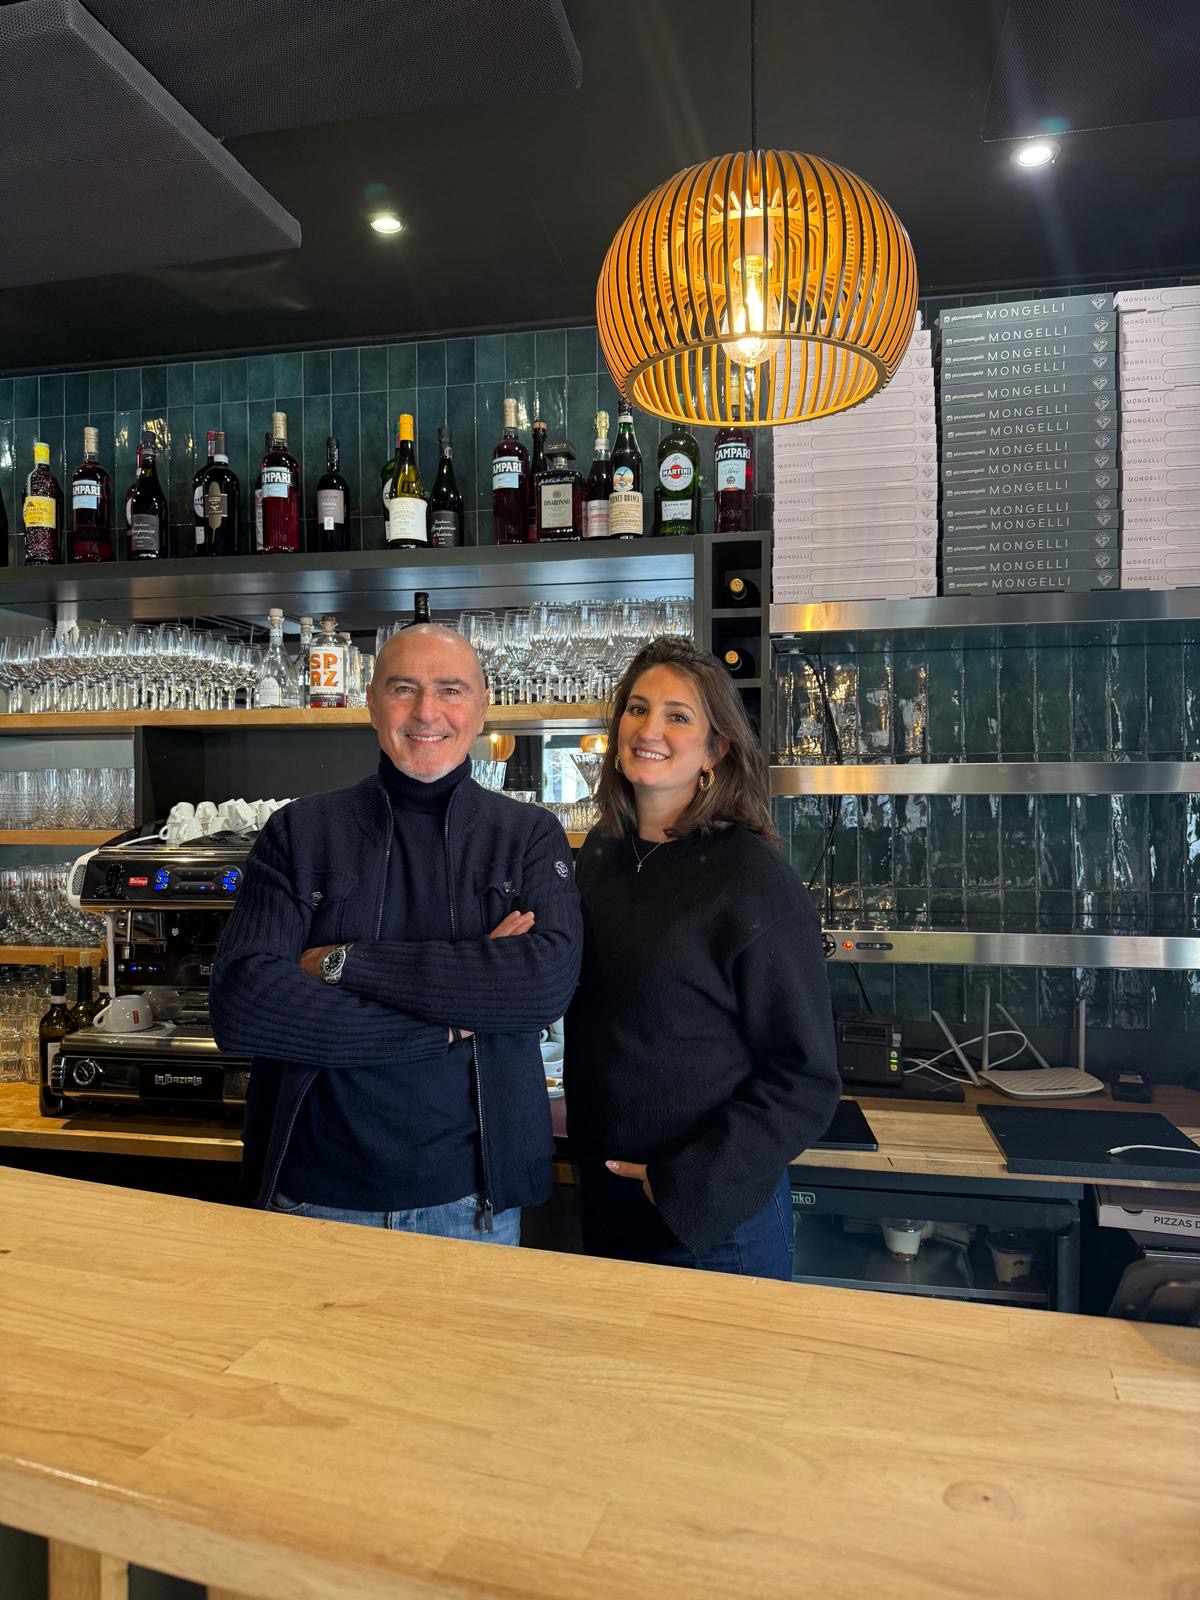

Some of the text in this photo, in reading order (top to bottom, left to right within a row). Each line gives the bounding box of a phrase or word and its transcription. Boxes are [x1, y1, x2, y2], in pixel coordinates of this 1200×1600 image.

[986, 302, 1065, 320] MONGELLI
[1124, 317, 1160, 325] MONGELLI
[988, 325, 1067, 342] MONGELLI
[987, 345, 1066, 361] MONGELLI
[987, 361, 1066, 377] MONGELLI
[987, 383, 1066, 399] MONGELLI
[989, 404, 1068, 419] MONGELLI
[990, 421, 1069, 436] MONGELLI
[715, 447, 751, 462] CAMPARI
[989, 441, 1068, 456] MONGELLI
[661, 467, 692, 478] MARTINI
[988, 459, 1067, 475] MONGELLI
[989, 479, 1068, 495] MONGELLI
[990, 502, 1069, 516] MONGELLI
[991, 517, 1070, 530] MONGELLI
[989, 539, 1068, 552] MONGELLI
[989, 558, 1069, 572] MONGELLI
[992, 576, 1071, 589] MONGELLI
[1153, 1216, 1193, 1228] PIZZAS
